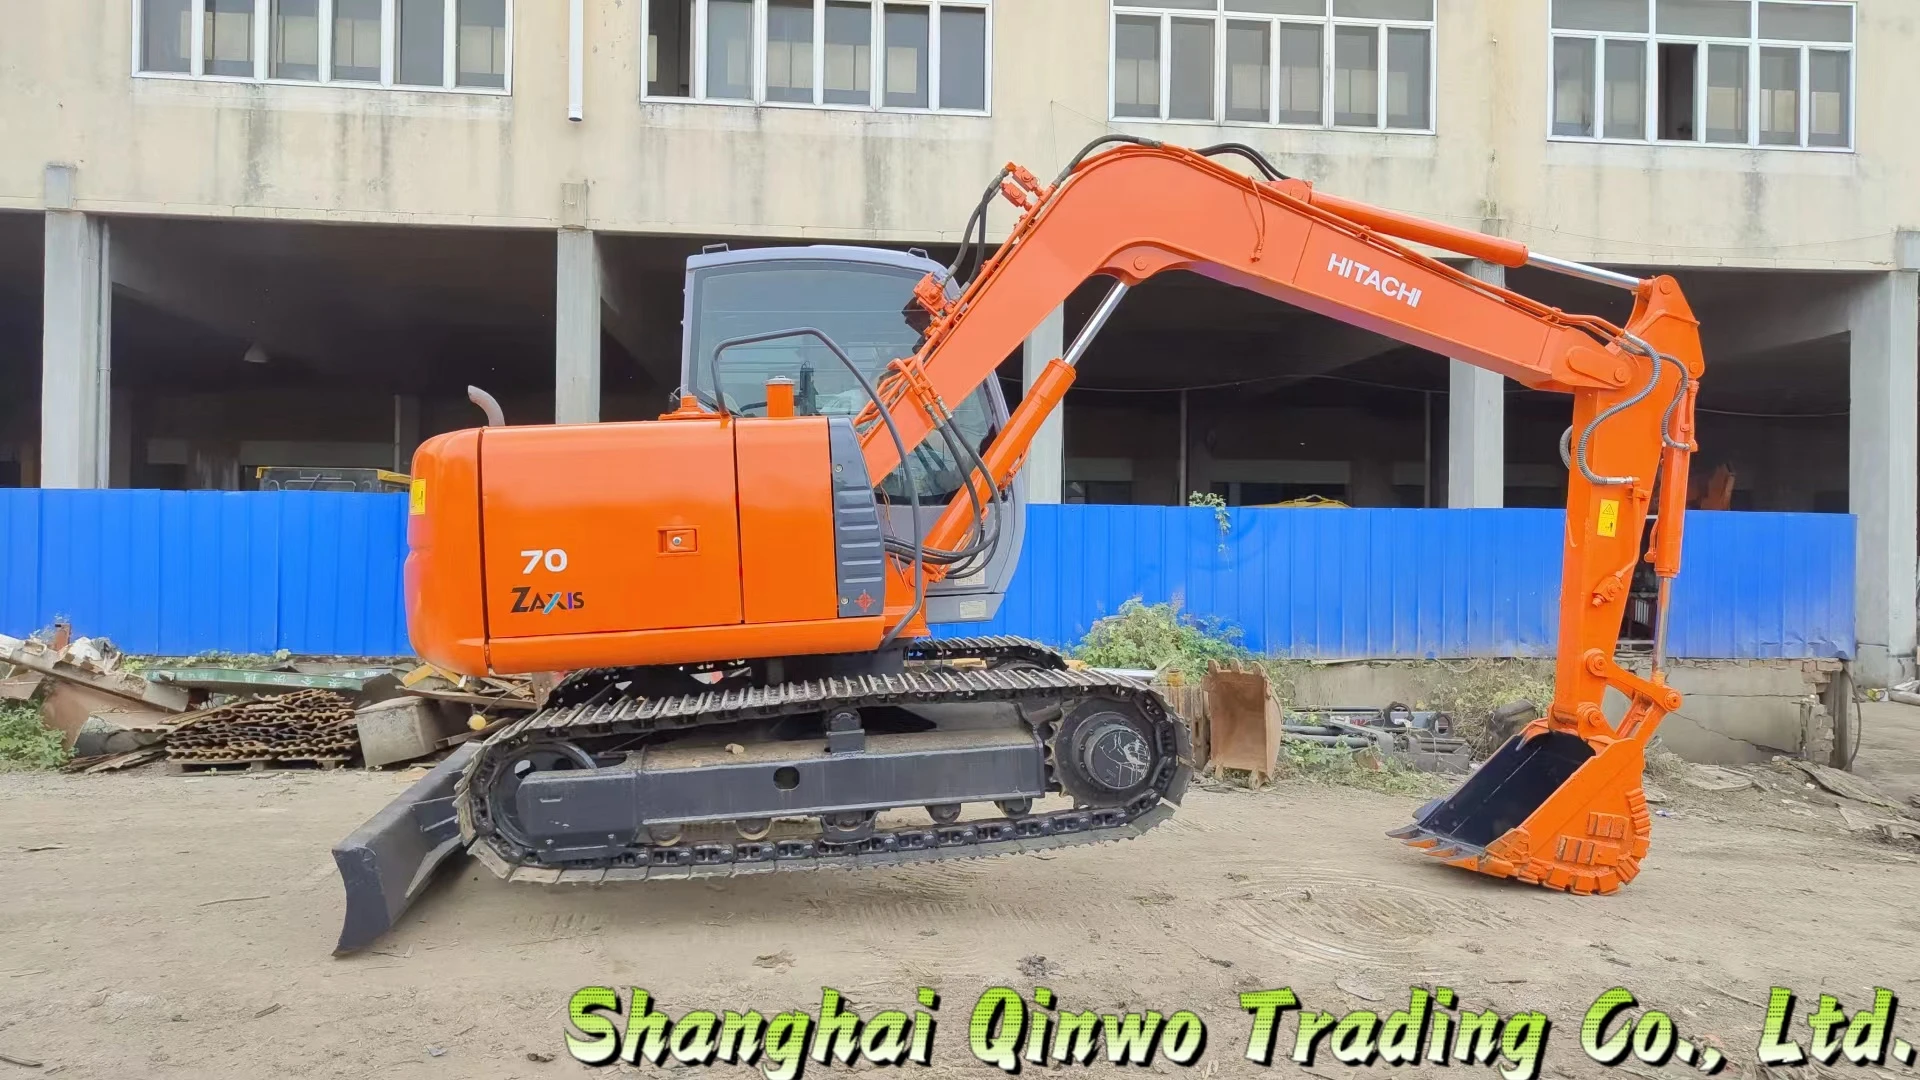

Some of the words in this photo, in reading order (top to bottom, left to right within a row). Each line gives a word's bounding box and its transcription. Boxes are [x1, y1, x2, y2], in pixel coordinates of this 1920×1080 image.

[1327, 253, 1422, 308] HITACHI
[520, 548, 568, 575] 70
[510, 586, 585, 614] ZAXIS
